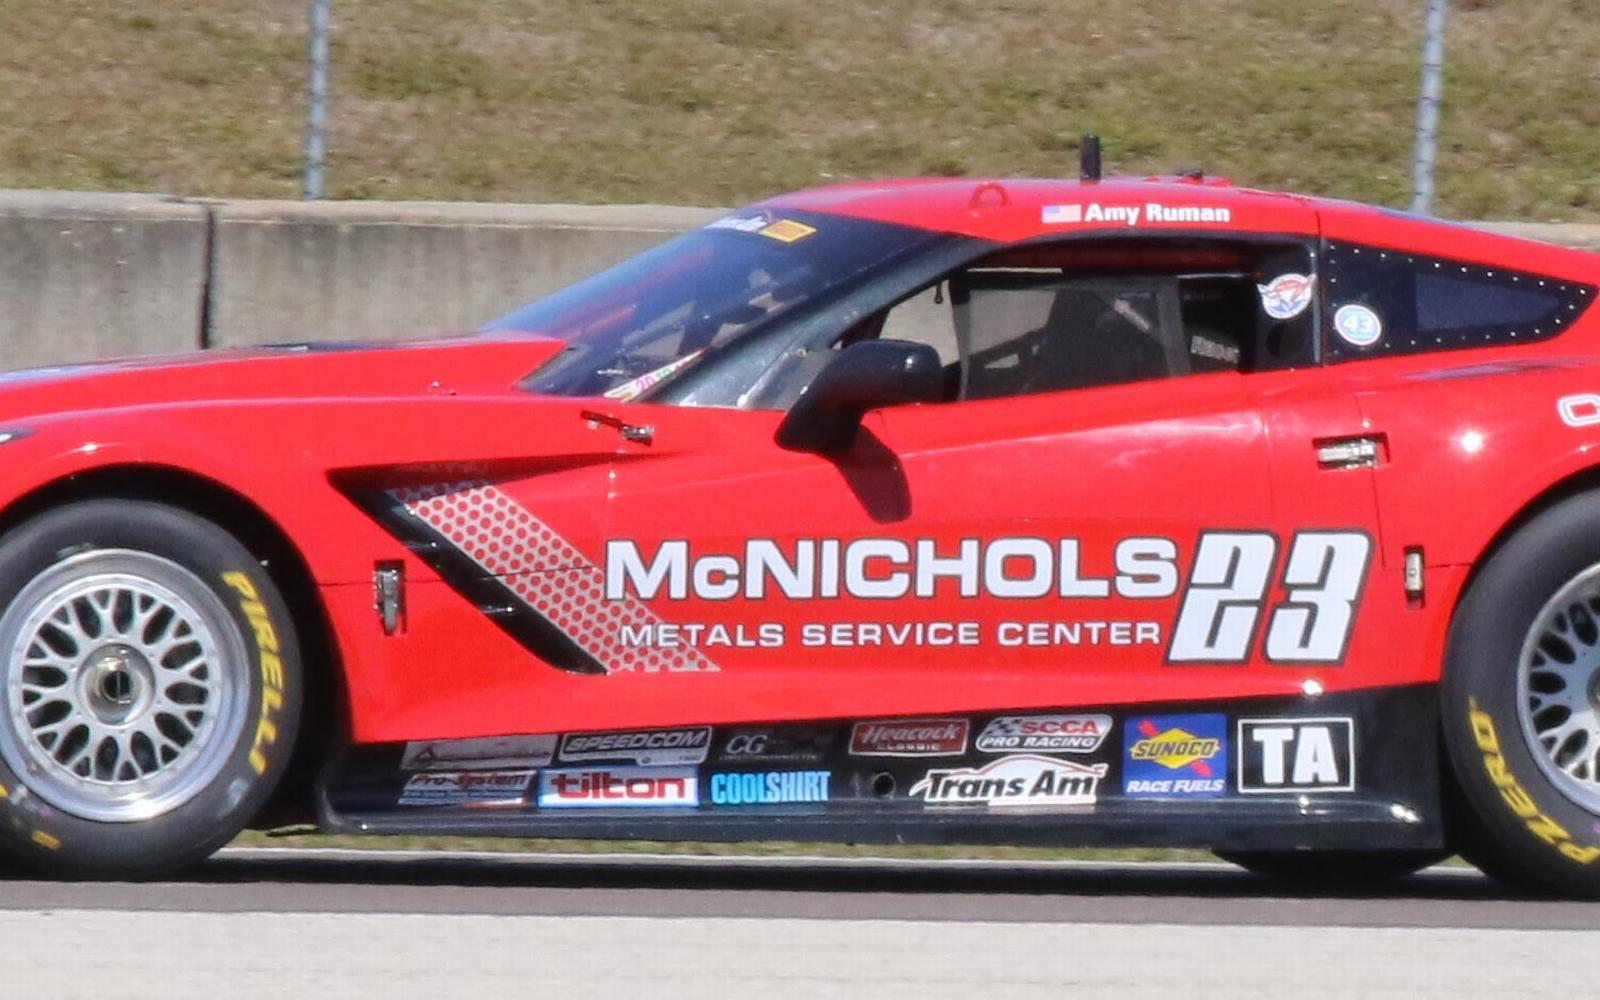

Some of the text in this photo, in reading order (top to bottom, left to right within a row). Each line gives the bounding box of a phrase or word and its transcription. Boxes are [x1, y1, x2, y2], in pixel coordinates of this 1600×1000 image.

[1084, 202, 1231, 226] Amy Ruman
[604, 537, 1180, 601] McNICHOLS
[1165, 529, 1373, 666] 23
[619, 620, 1162, 649] METALS SERVICE CENTER
[220, 571, 284, 777] PIRELLI
[565, 729, 707, 752] SPEEDCOM
[981, 735, 1096, 747] PRO RACING
[1020, 719, 1100, 735] SCCA
[725, 734, 768, 754] CG
[1133, 739, 1217, 758] SUNOCO
[1252, 726, 1339, 784] TA
[553, 771, 685, 799] tilton
[711, 770, 831, 804] COOLSHIRT
[926, 769, 1095, 799] Trans Am
[1126, 778, 1225, 793] RACE FUELS
